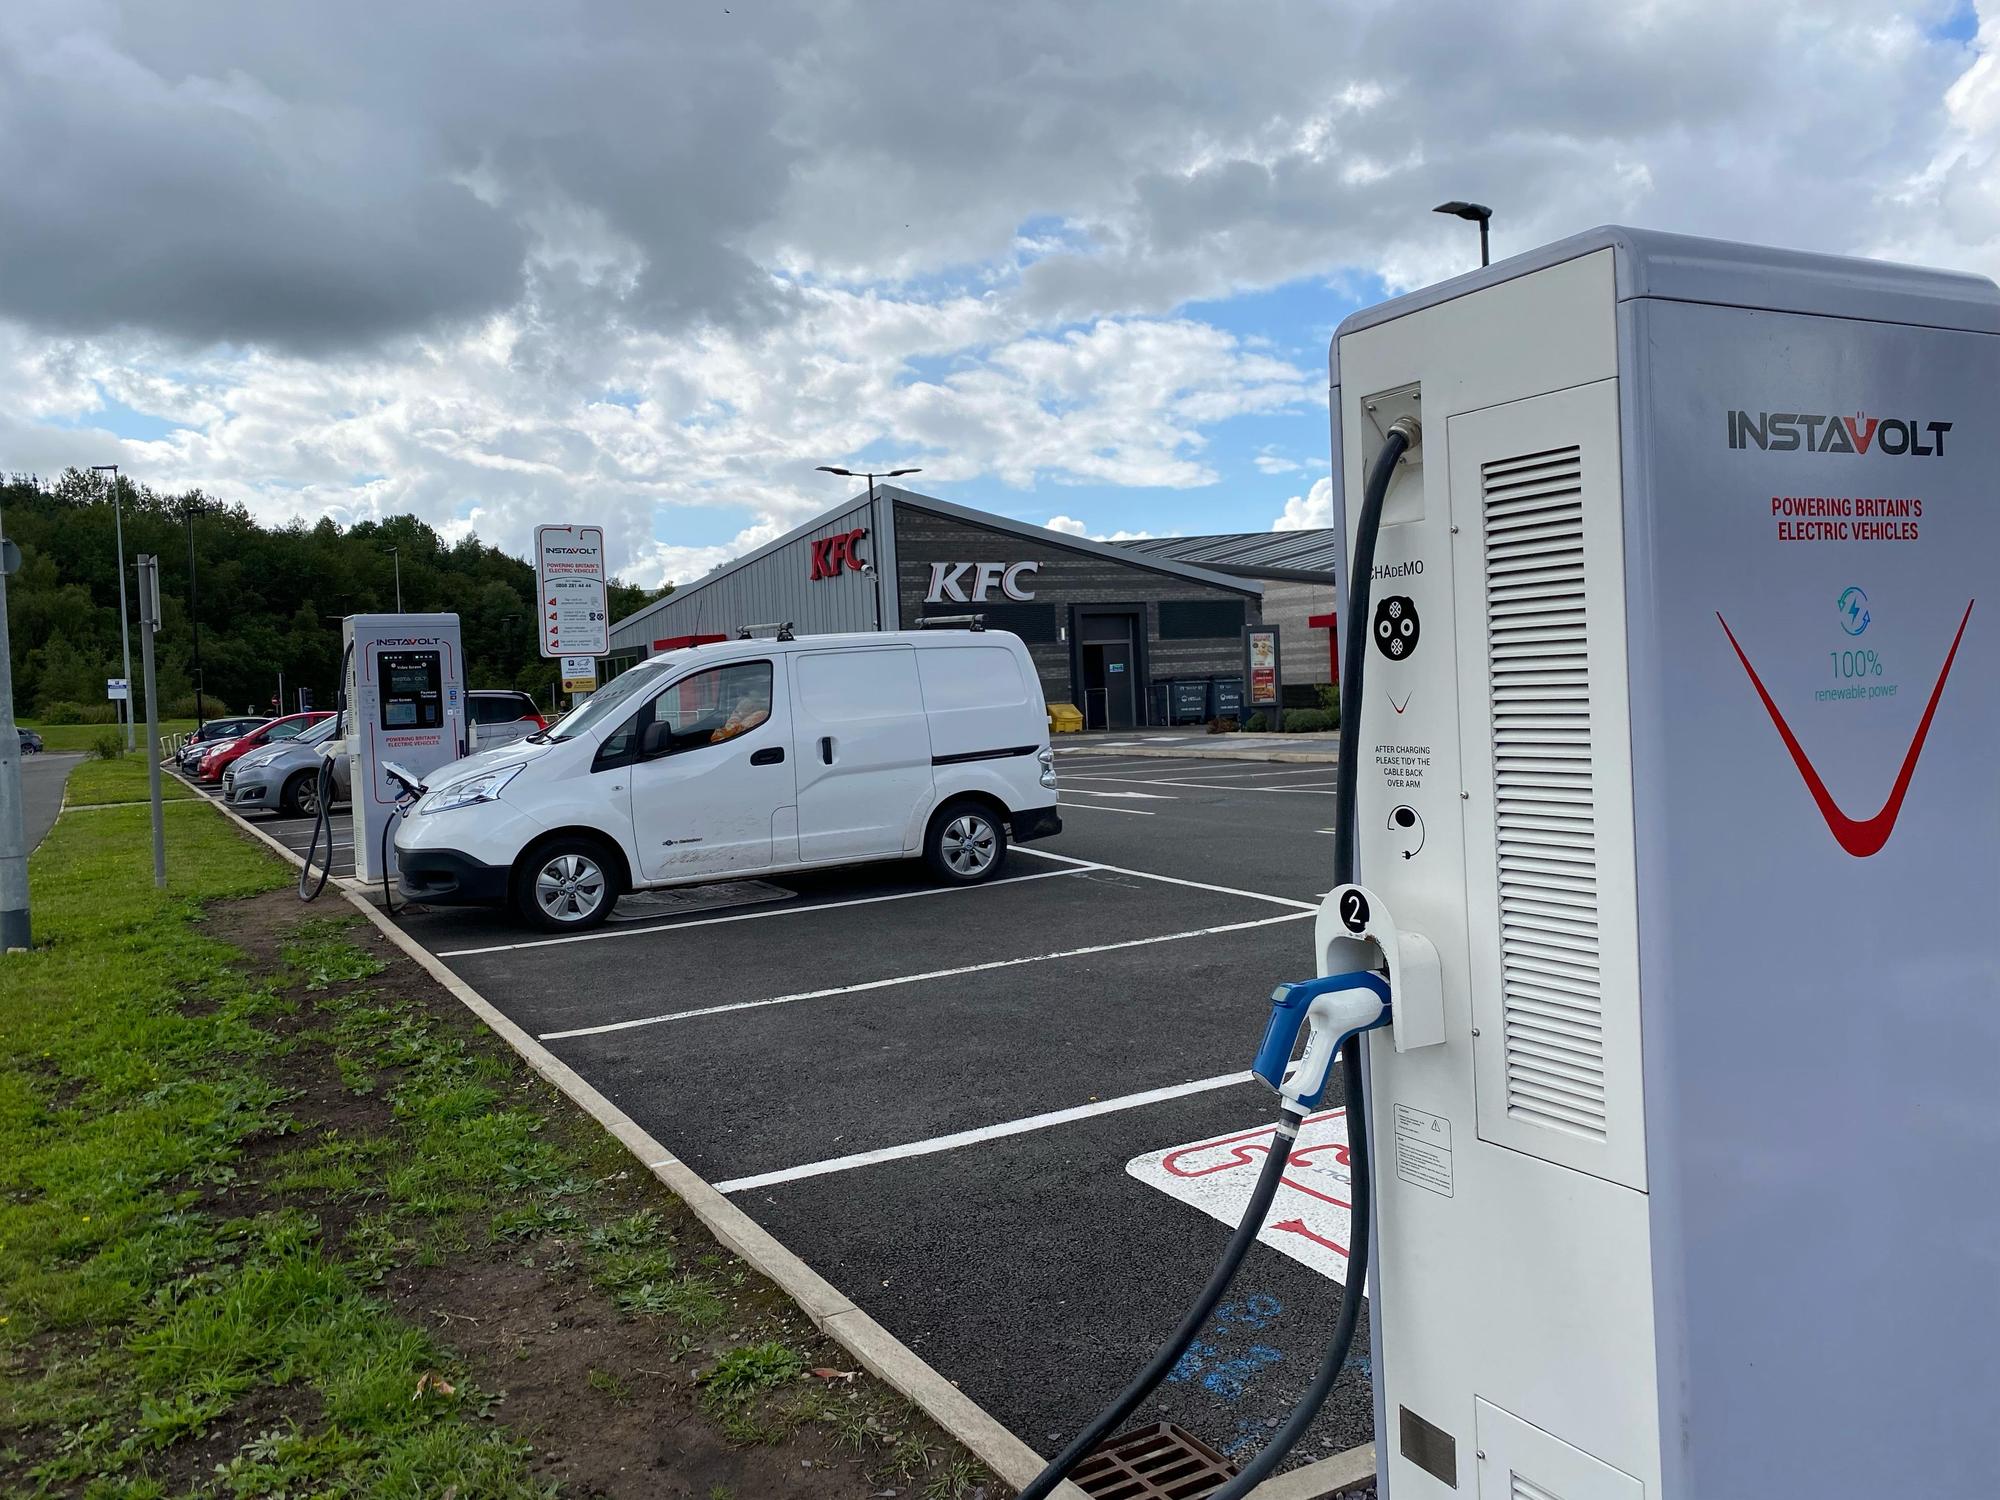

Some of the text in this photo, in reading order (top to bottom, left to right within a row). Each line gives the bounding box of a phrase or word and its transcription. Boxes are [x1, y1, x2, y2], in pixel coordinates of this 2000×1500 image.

[1728, 411, 1953, 456] INSTAVOLT
[1771, 497, 1922, 517] POWERING BRITAIN'S
[1778, 522, 1918, 540] ELECTRIC VEHICLES
[545, 547, 598, 555] INSTAVOLT
[810, 528, 866, 581] KFC
[924, 561, 1039, 603] KFC
[376, 637, 440, 646] INSTAVOLT
[1830, 649, 1882, 679] 100%
[1815, 685, 1898, 701] renewable power
[1375, 745, 1430, 754] AFTER CHARGING
[1375, 756, 1430, 766] PLEASE TIDY THE
[1383, 767, 1423, 777] CABLE BACK
[1387, 779, 1421, 788] OVER ARM
[1348, 895, 1361, 924] 2
